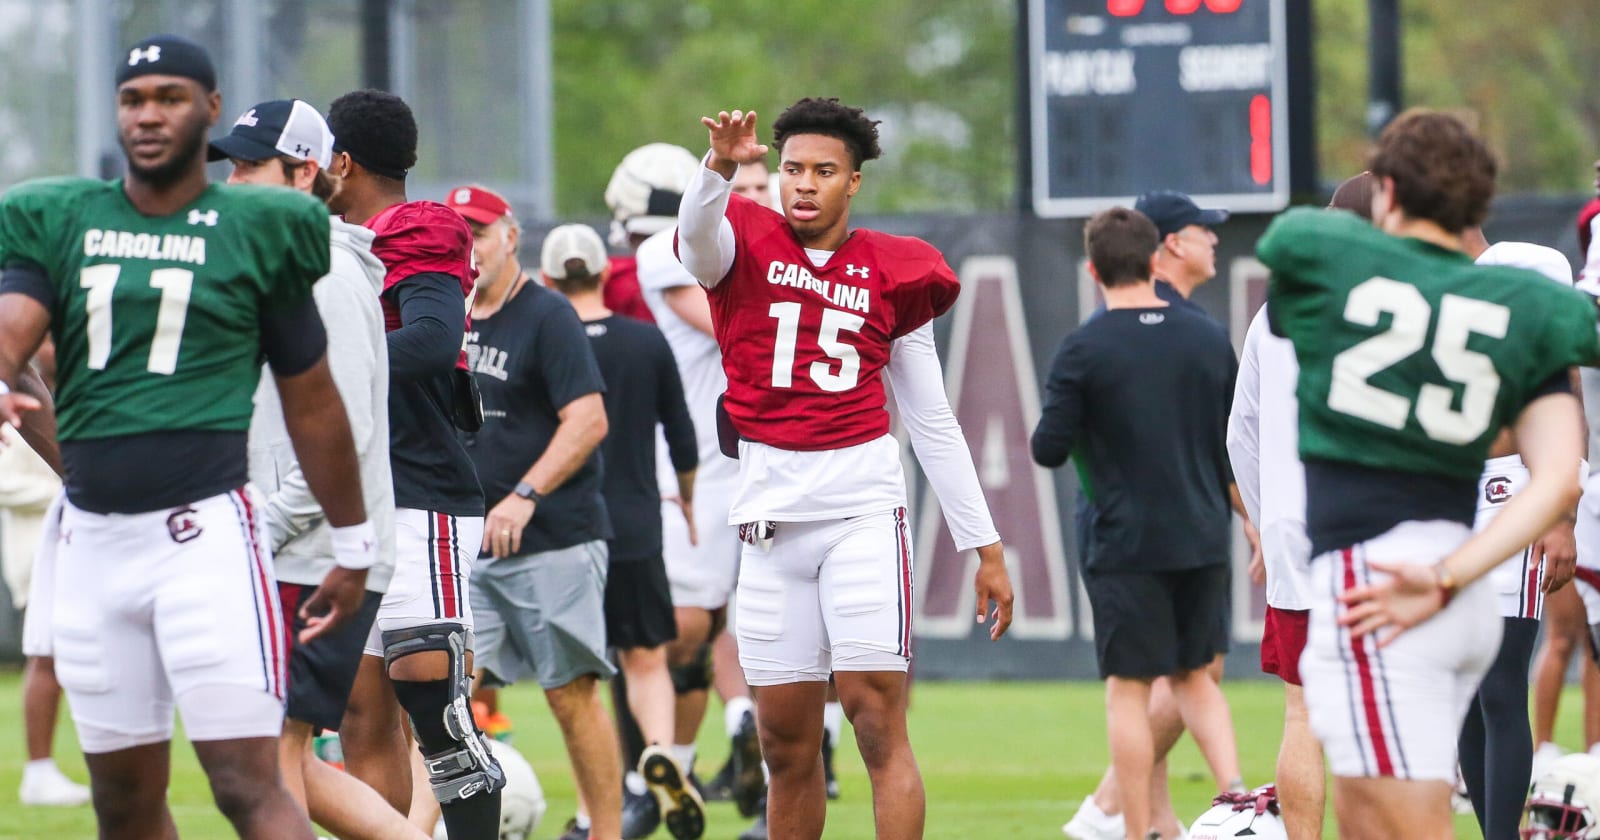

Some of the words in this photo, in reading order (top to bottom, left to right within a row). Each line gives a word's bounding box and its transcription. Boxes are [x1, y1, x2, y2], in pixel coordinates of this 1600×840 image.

[84, 229, 206, 265] CAROLINA
[767, 260, 870, 313] CAROLINA
[80, 263, 194, 375] 11
[768, 301, 865, 392] 15
[1327, 276, 1510, 446] 25
